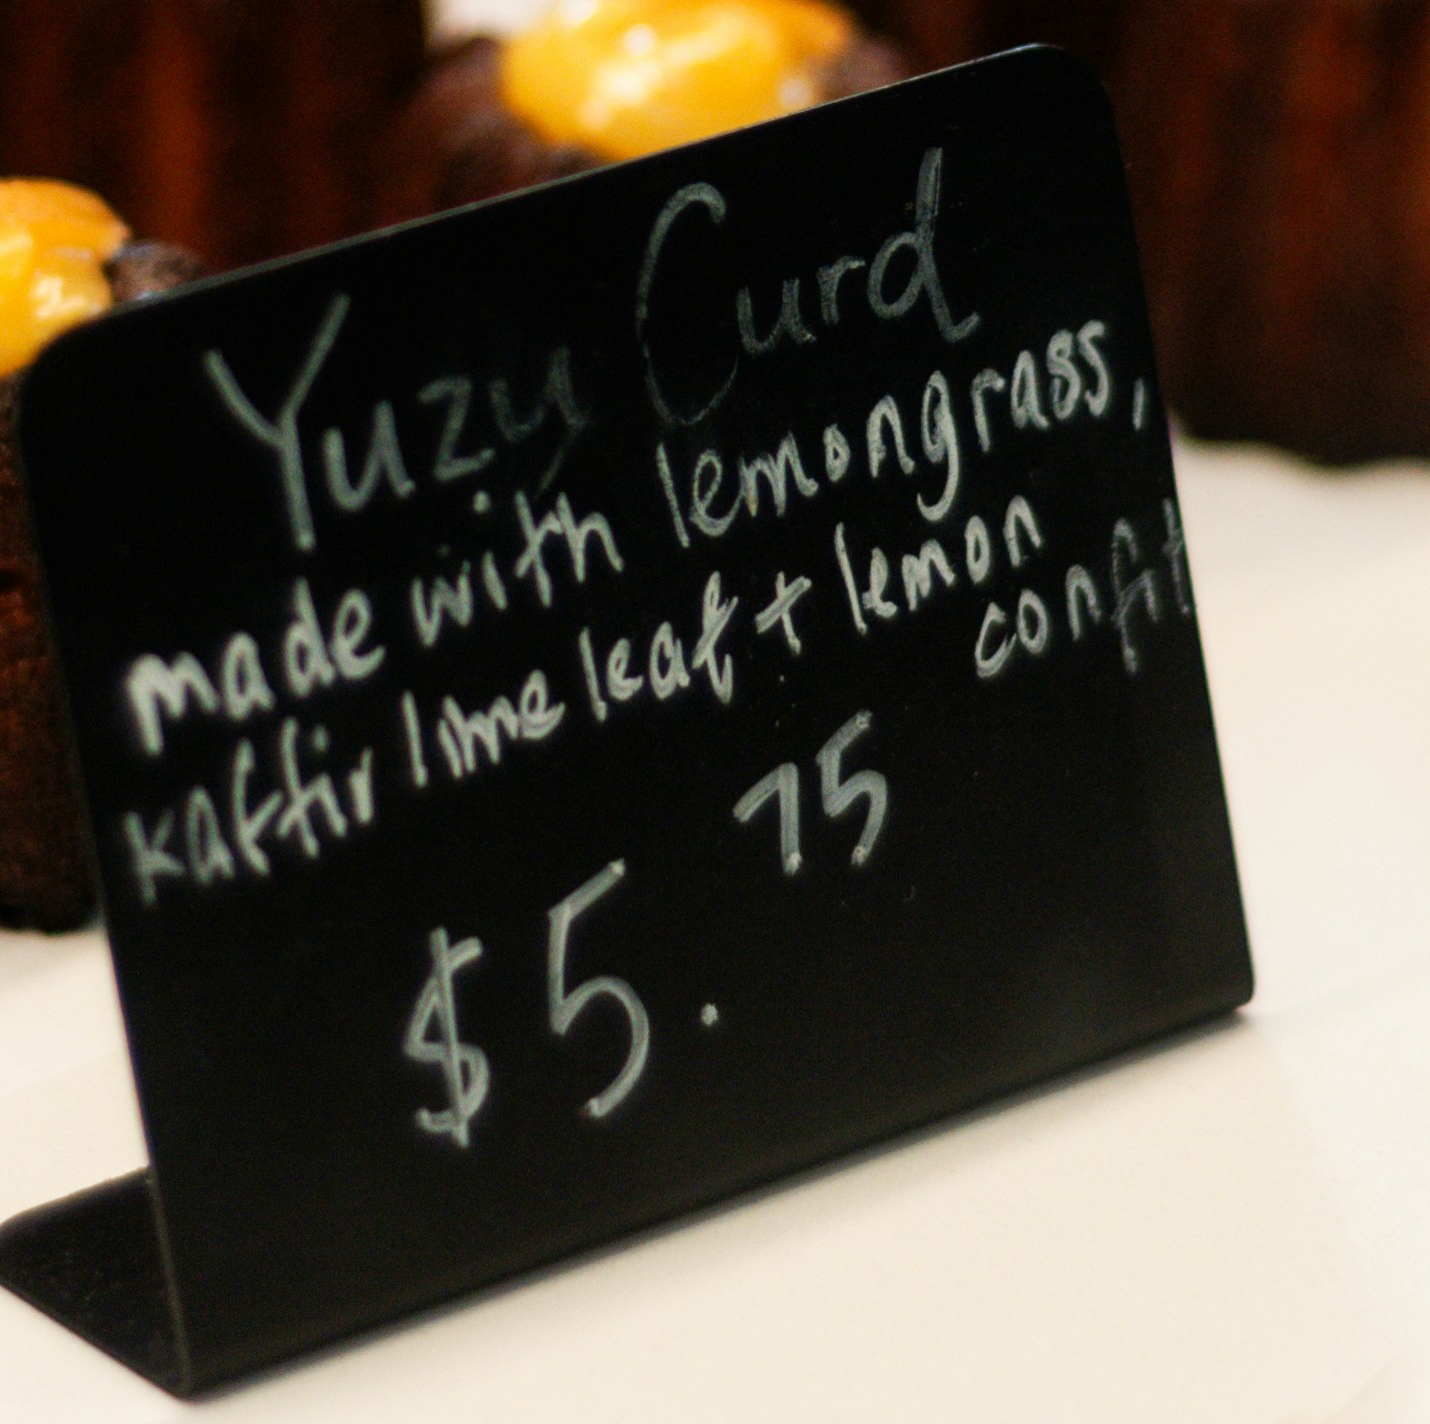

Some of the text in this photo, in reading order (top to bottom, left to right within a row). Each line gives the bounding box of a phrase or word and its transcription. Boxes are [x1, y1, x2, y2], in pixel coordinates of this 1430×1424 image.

[634, 147, 981, 429] Curd
[122, 716, 374, 907] kaffir
[401, 669, 567, 789] lime
[578, 570, 740, 723] leaf
[834, 494, 1043, 636] lemon
[126, 319, 1145, 756] made with lemongrass,
